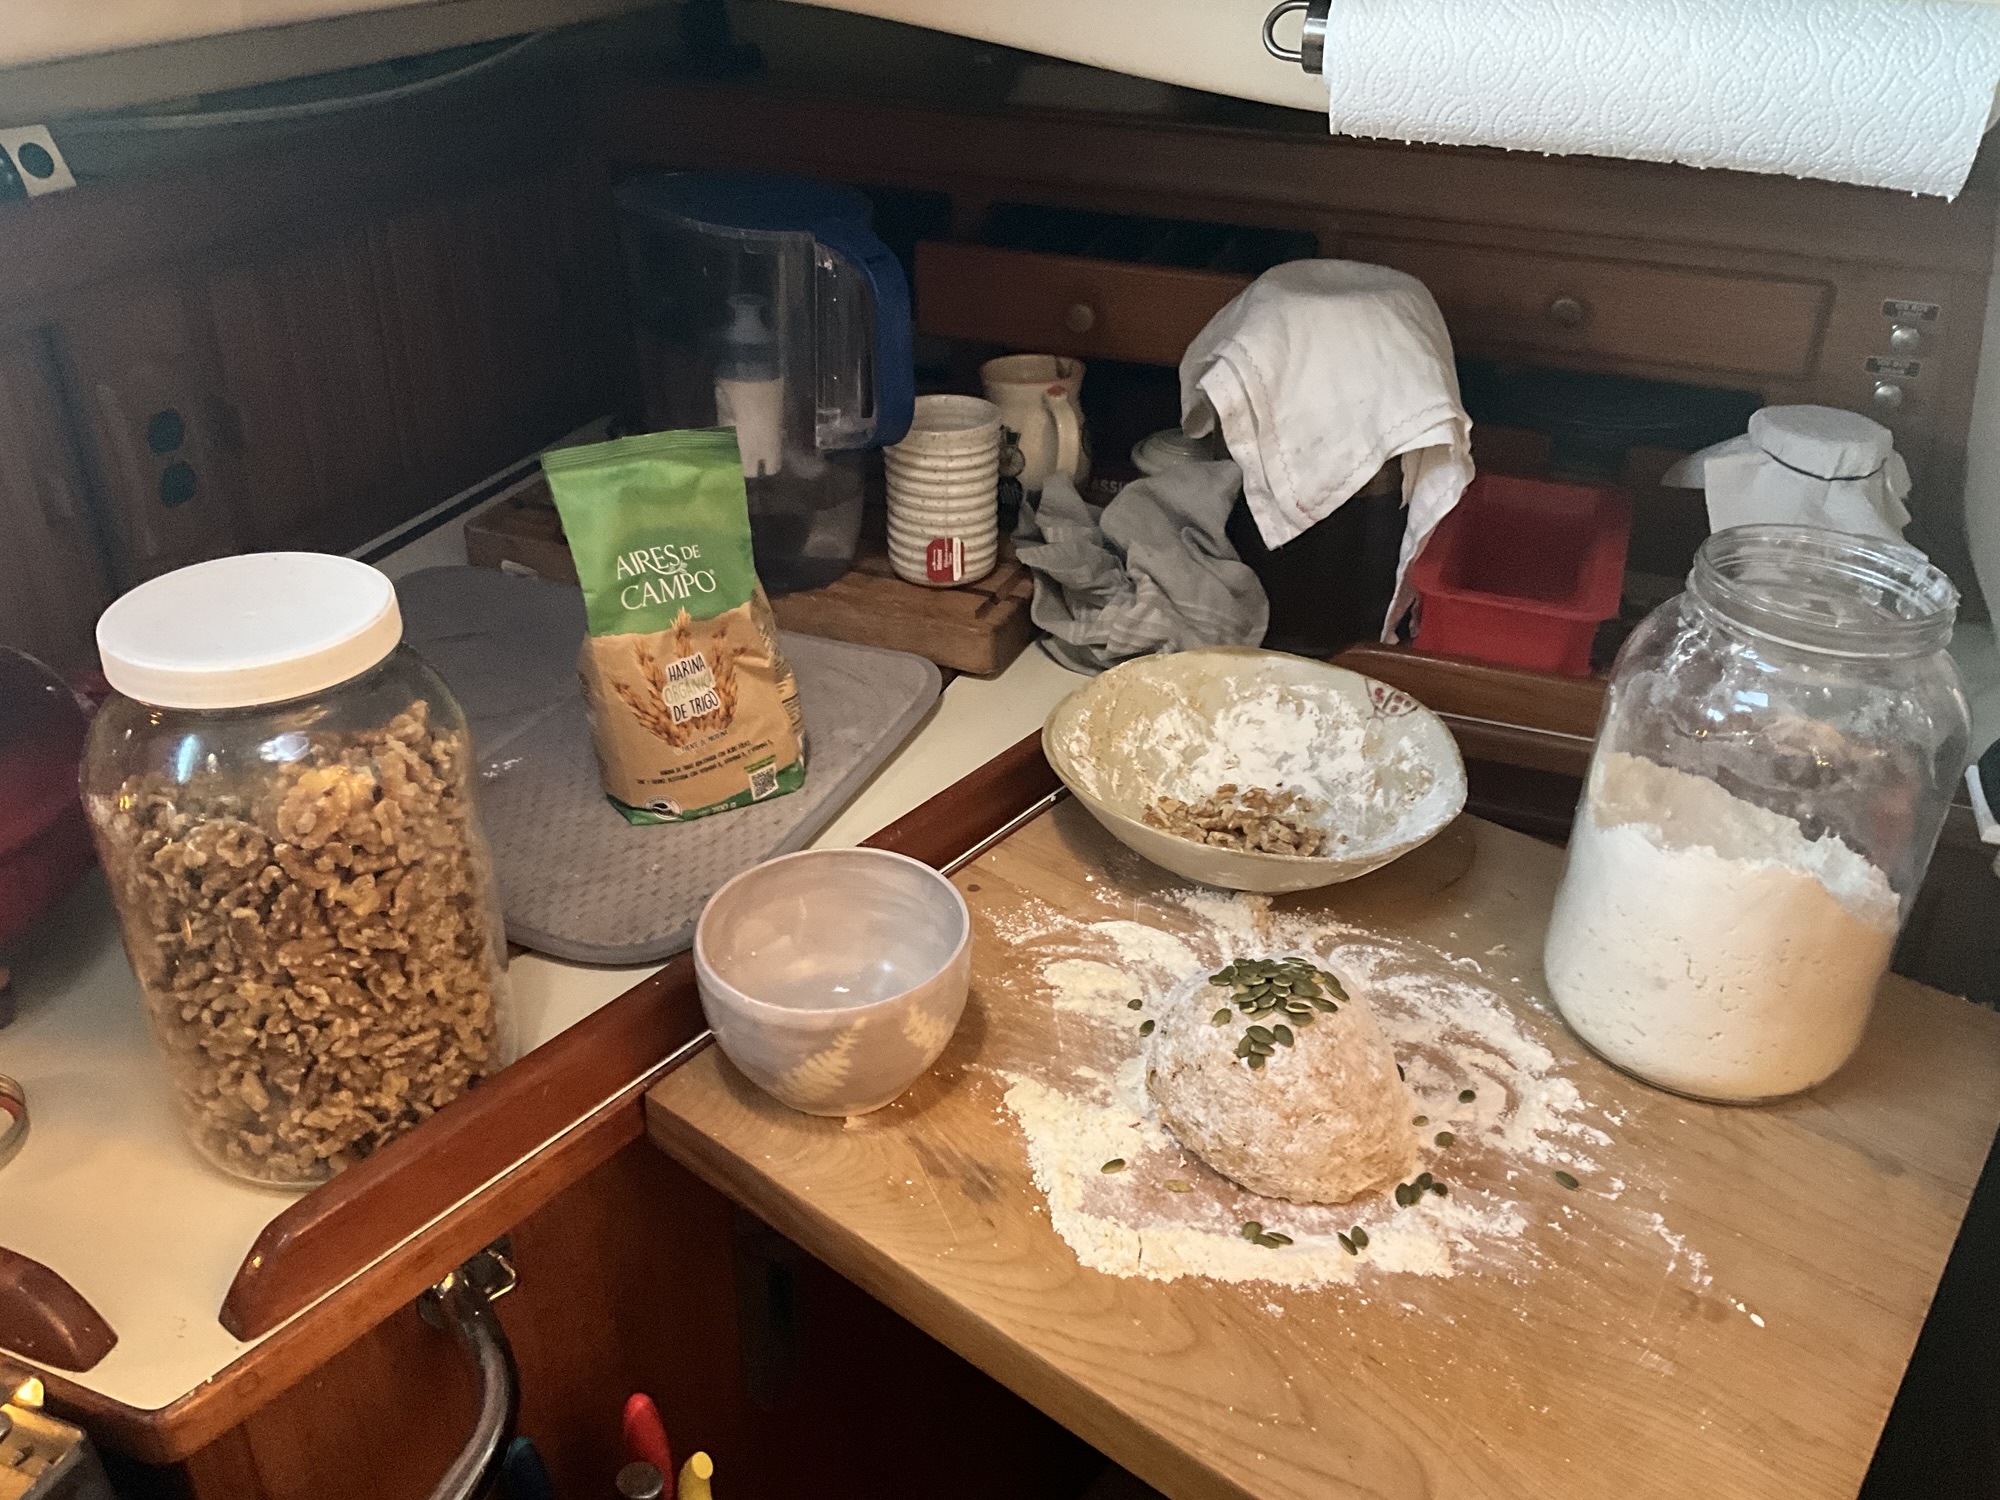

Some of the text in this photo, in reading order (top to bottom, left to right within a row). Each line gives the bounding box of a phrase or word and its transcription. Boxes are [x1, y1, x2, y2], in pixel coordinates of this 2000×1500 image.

[617, 544, 701, 580] AIRES DE
[621, 570, 716, 610] CAMPO
[668, 654, 706, 682] HARINA
[673, 690, 719, 722] DE TRIGO
